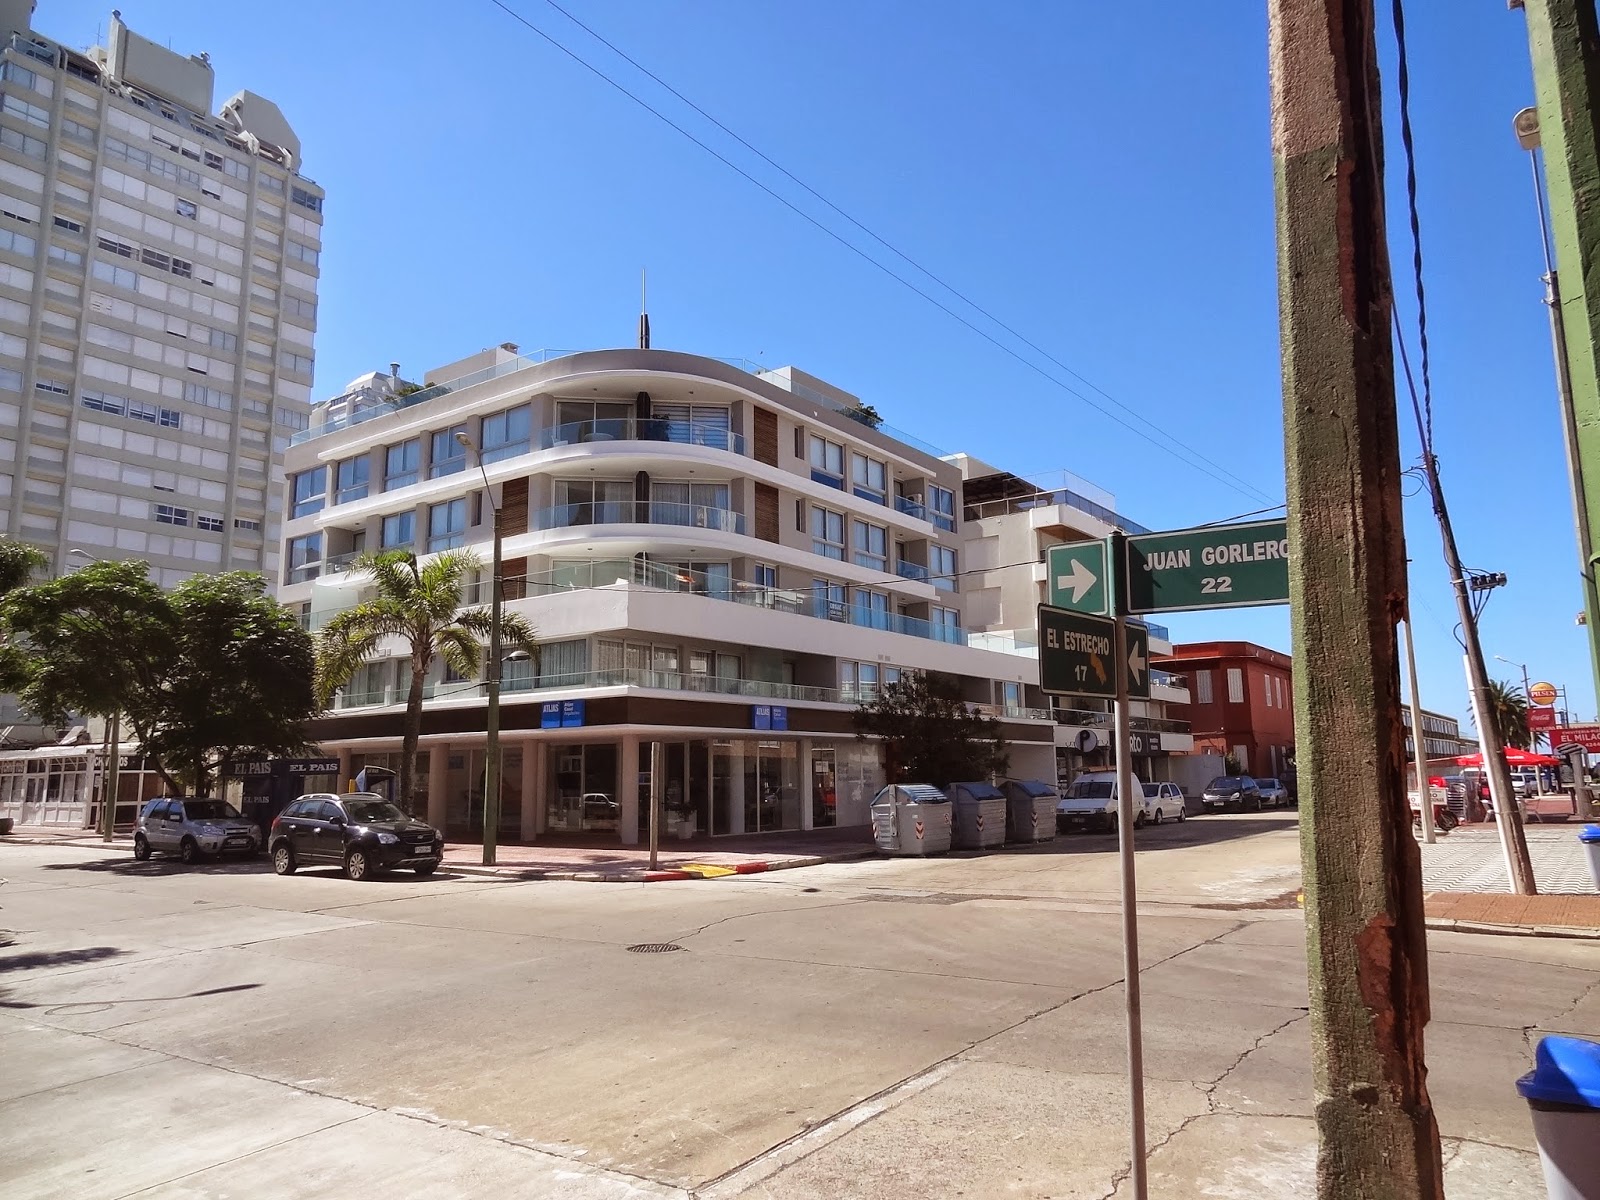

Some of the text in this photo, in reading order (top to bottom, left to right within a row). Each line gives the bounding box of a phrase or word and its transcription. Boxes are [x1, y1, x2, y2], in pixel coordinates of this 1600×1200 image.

[1143, 539, 1289, 571] JUAN GORLERO
[1201, 576, 1232, 594] 22
[1047, 627, 1110, 656] EL ESTRECHO
[1074, 665, 1087, 681] 17
[235, 761, 272, 775] EL PAIS
[289, 763, 338, 772] EL PAIS
